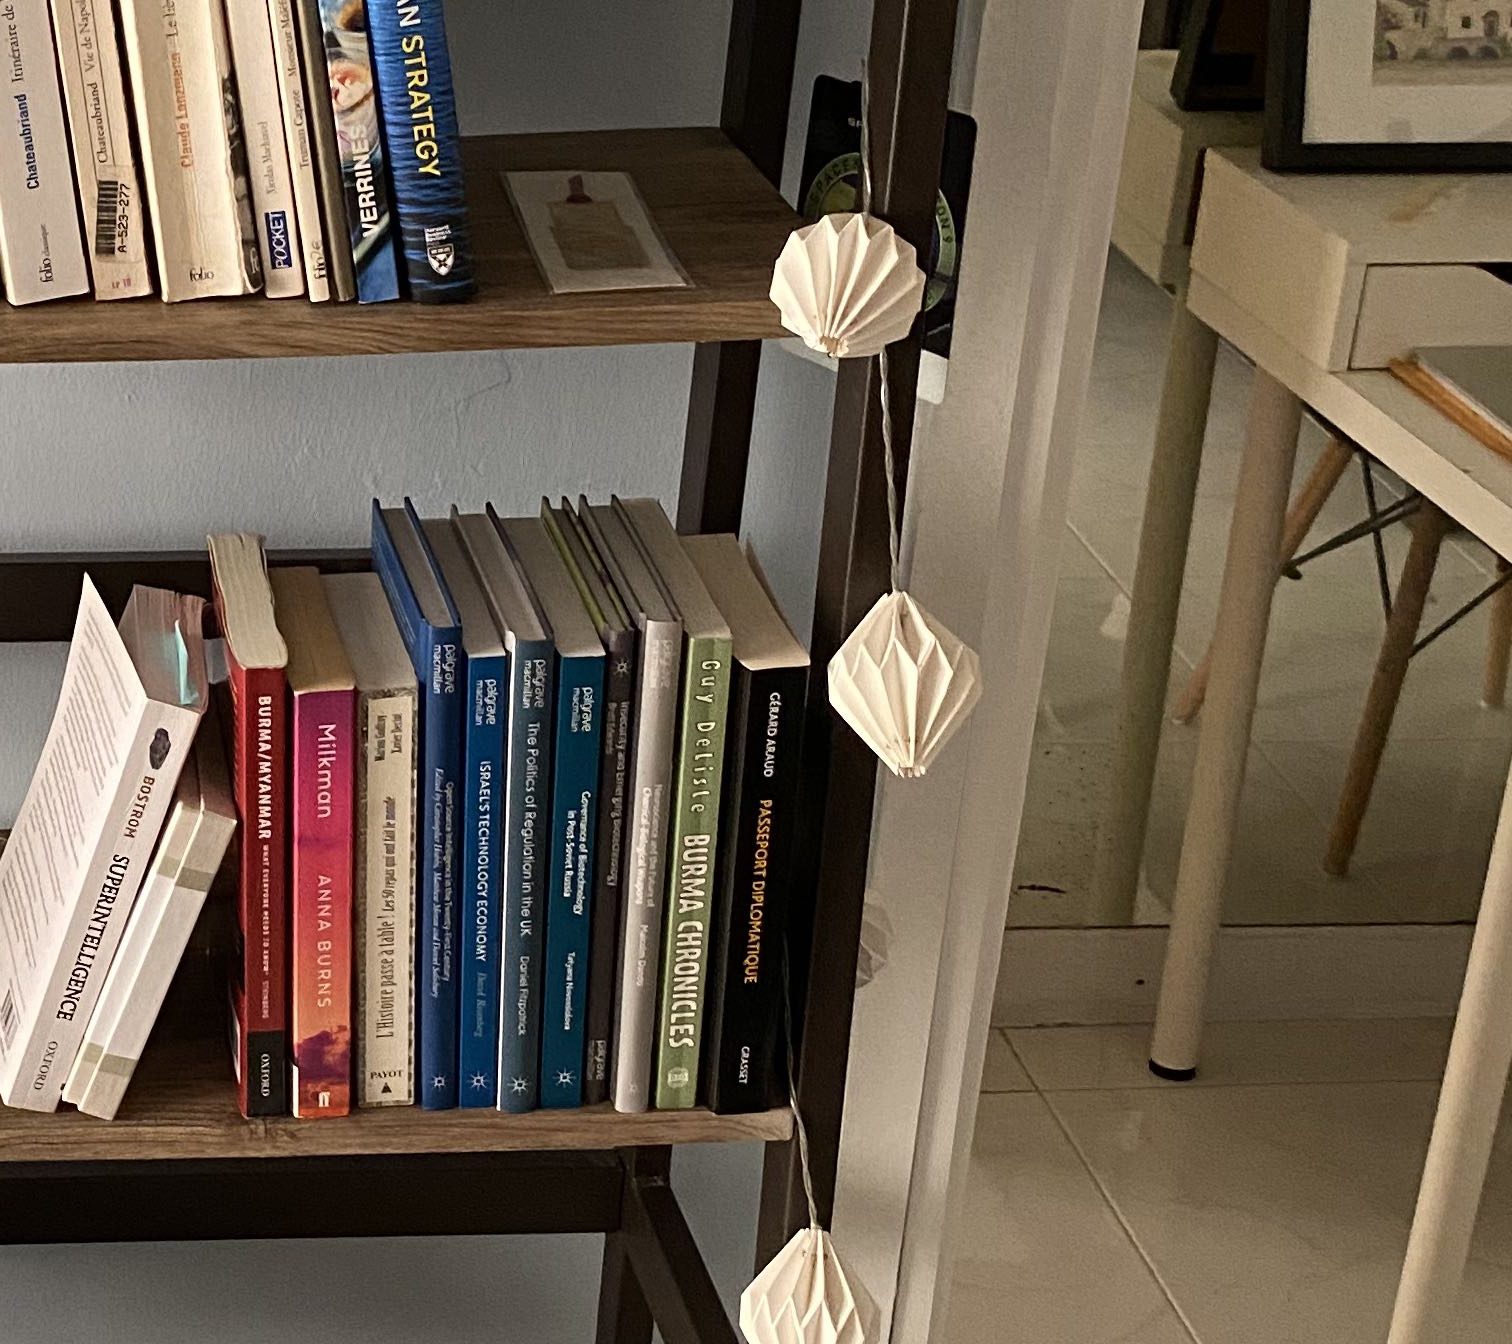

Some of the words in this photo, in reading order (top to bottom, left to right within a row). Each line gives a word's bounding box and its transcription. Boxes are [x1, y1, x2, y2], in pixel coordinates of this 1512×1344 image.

[1, 5, 15, 21] de
[84, 50, 96, 76] Vie
[87, 81, 109, 164] Chateaubriand
[401, 35, 441, 177] STRATEGY
[16, 93, 41, 191] Chateaubriand
[177, 122, 194, 168] Claude
[350, 123, 379, 239] VERRINES
[117, 183, 131, 253] A-523-277
[269, 212, 289, 269] POCKET
[432, 644, 443, 694] macmillan
[442, 644, 456, 694] palgrave
[522, 659, 533, 709] macmillan
[533, 659, 547, 708] palgrave
[695, 659, 721, 704] Guy
[475, 679, 484, 726] macmillan
[484, 678, 499, 725] palgrave
[571, 687, 581, 733] macmillan
[580, 686, 595, 733] palgrave
[766, 691, 781, 739] GÉRARD
[527, 721, 540, 746] The
[257, 695, 272, 840] BURMA/MYANMAR
[317, 724, 337, 819] Milkman
[525, 748, 539, 792] Politics
[689, 720, 716, 814] Delisle
[763, 740, 778, 778] ARAUD
[123, 775, 155, 839] BOSTROM
[524, 794, 538, 809] of
[578, 791, 592, 842] Governance
[476, 812, 491, 900] TECHNOLOGY
[520, 811, 537, 883] Regulation
[564, 820, 576, 869] Post-Soviet
[577, 843, 588, 854] of
[753, 798, 774, 879] PASSEPORT
[521, 883, 536, 894] in
[563, 870, 573, 897] Russia
[573, 854, 588, 916] Biotechnology
[678, 833, 711, 914] BURMA
[317, 875, 332, 931] ANNA
[520, 895, 535, 918] the
[56, 853, 130, 1022] SUPERINTELLIGENCE
[377, 920, 395, 946] table
[475, 902, 488, 962] ECONOMY
[520, 920, 532, 937] UK
[744, 881, 767, 985] DIPLOMATIQUE
[317, 940, 332, 1009] BURNS
[379, 959, 397, 987] passe
[518, 955, 530, 987] Daniel
[668, 920, 705, 1049] CHRONICLES
[376, 987, 395, 1040] L'Histoire
[34, 1040, 58, 1092] OXFORD
[261, 1053, 270, 1097] OXFORD
[370, 1069, 403, 1080] PAYOT
[738, 1045, 751, 1085] GRASSET
